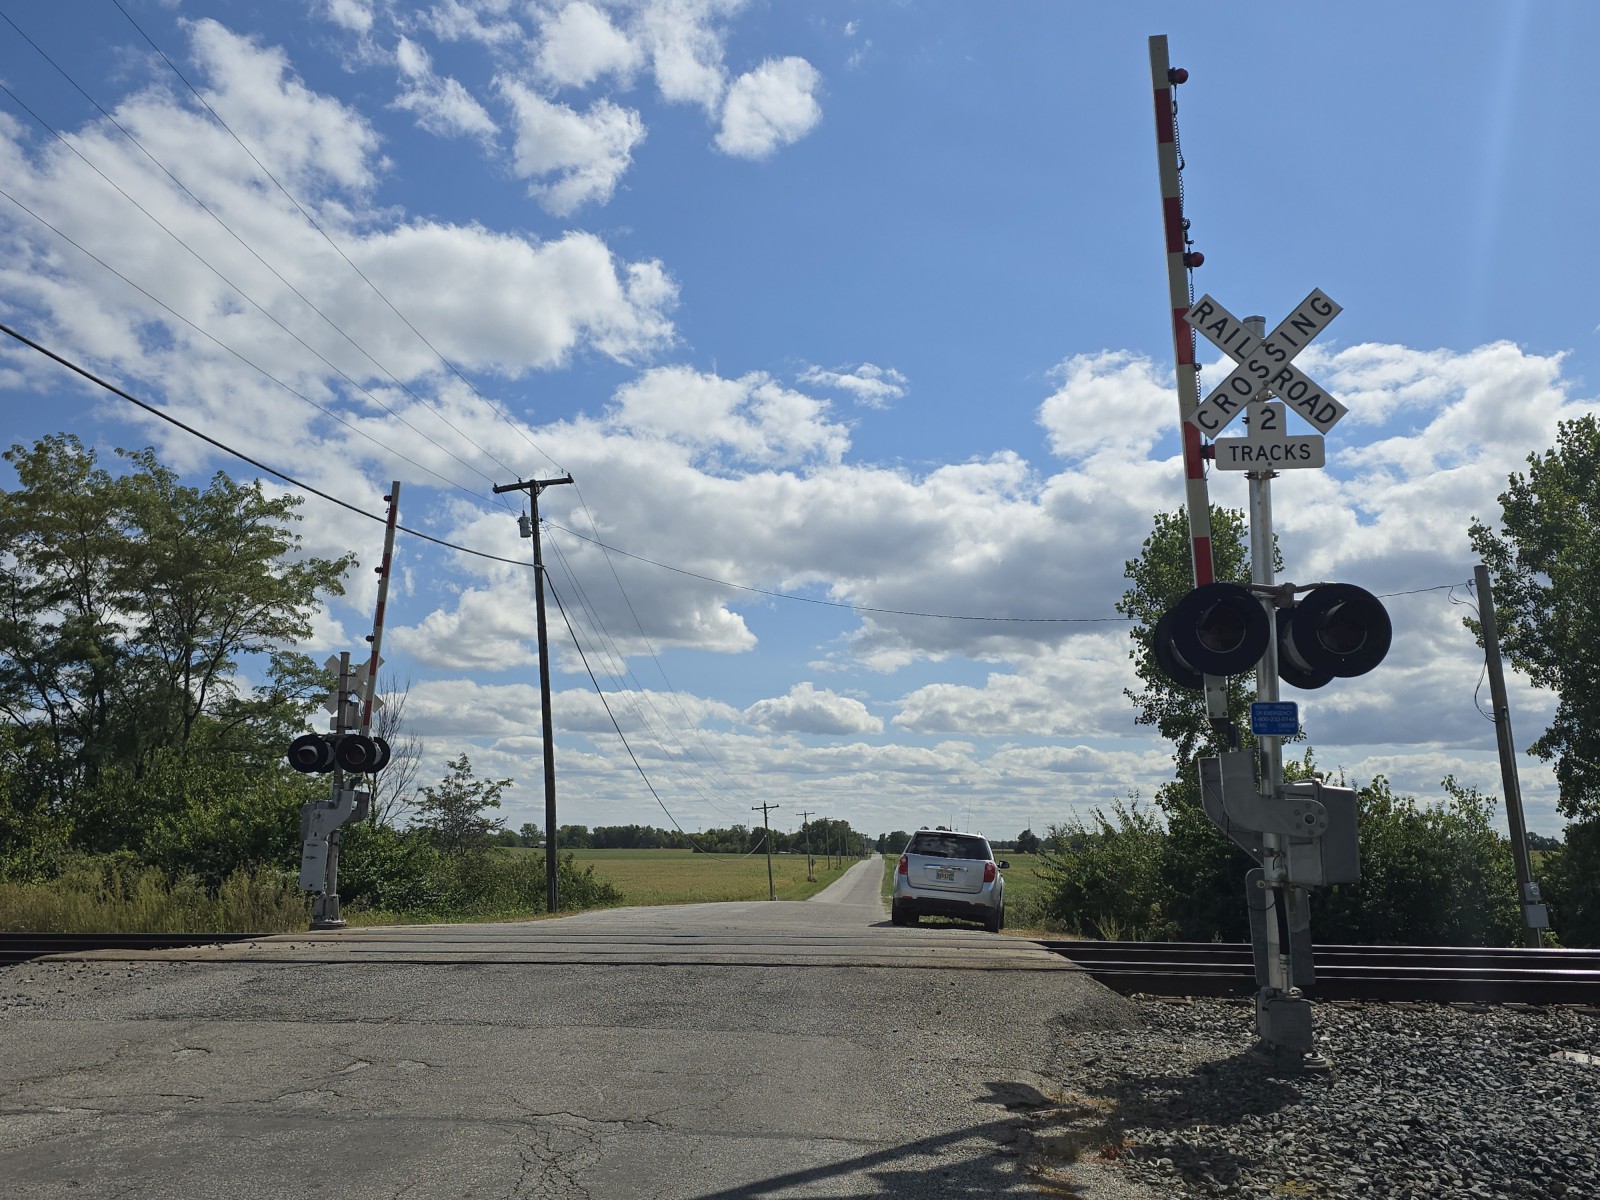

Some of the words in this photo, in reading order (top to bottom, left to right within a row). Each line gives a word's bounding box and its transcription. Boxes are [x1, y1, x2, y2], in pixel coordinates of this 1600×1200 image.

[1197, 296, 1333, 430] CROSSING
[1260, 408, 1277, 430] 2
[1229, 443, 1311, 462] TRACKS
